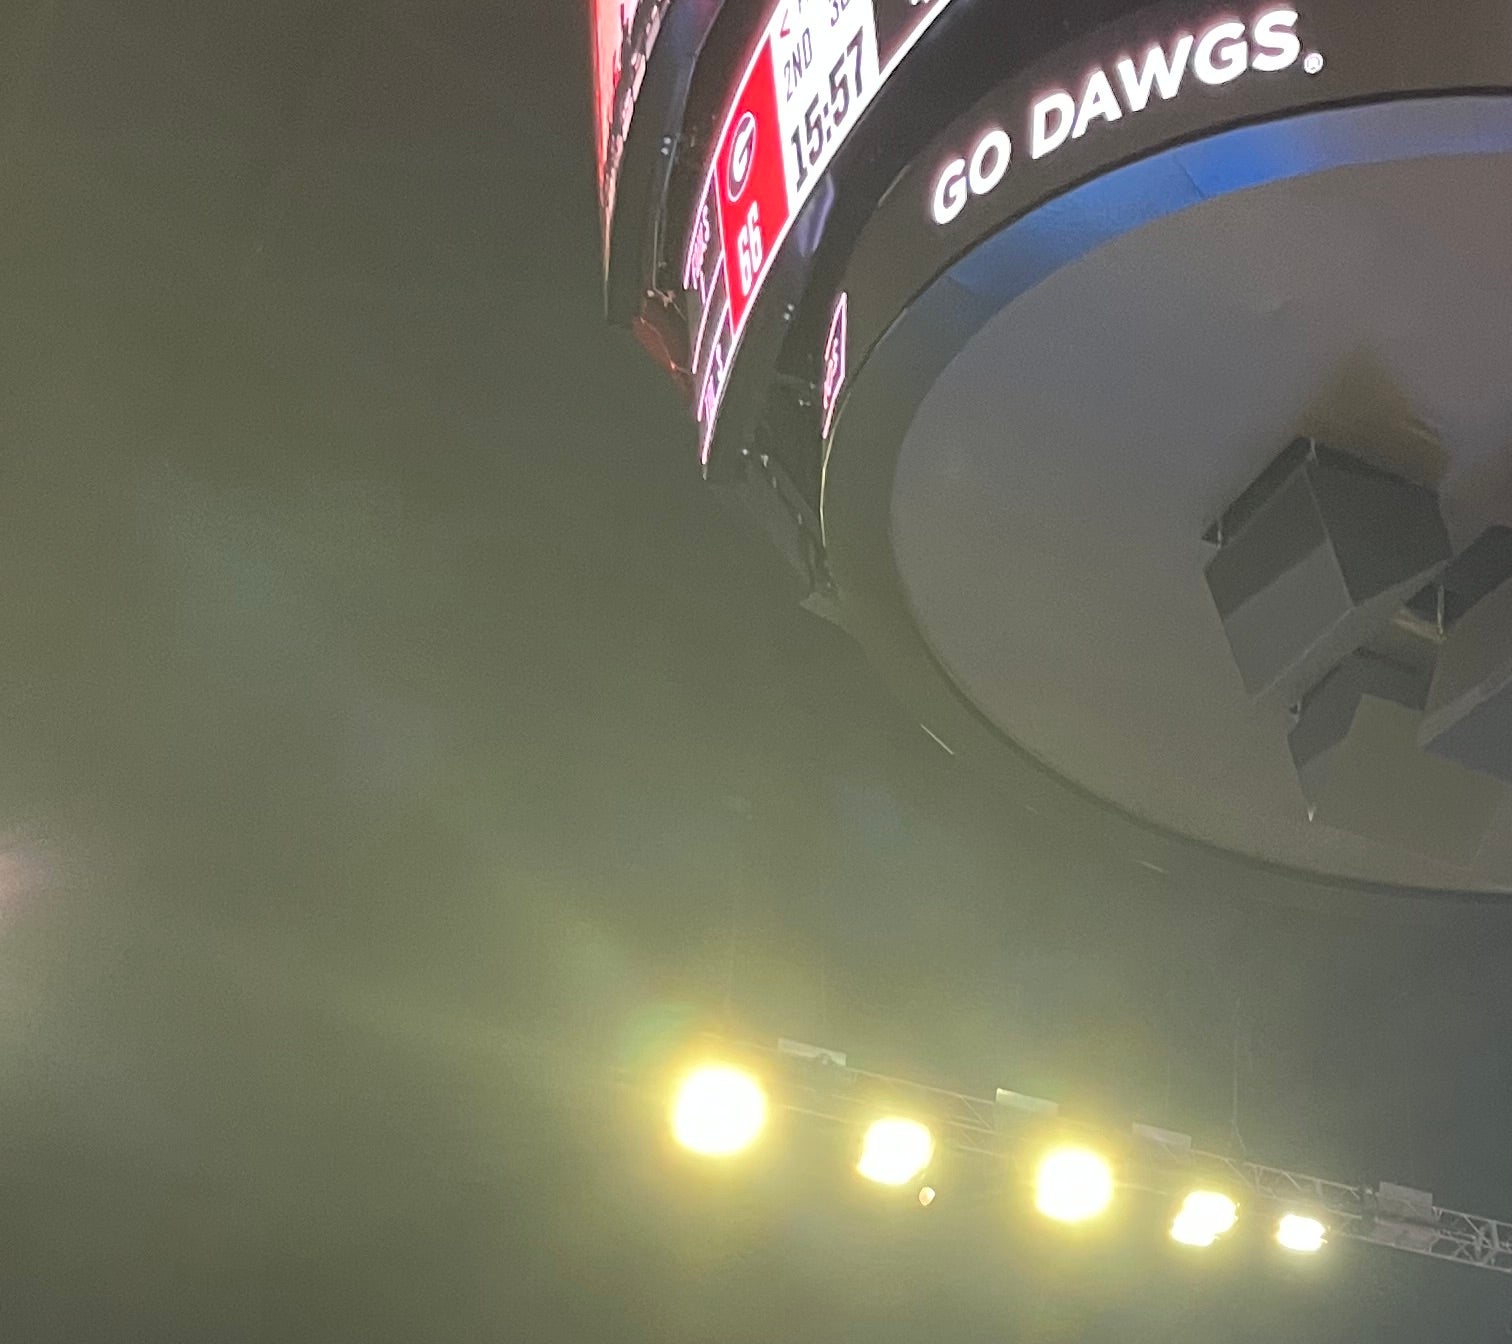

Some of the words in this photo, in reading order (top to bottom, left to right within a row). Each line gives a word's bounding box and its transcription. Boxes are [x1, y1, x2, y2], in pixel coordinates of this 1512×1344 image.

[783, 27, 813, 102] 2ND
[790, 25, 864, 192] 15:57
[932, 129, 1012, 226] GO
[738, 200, 763, 297] 66
